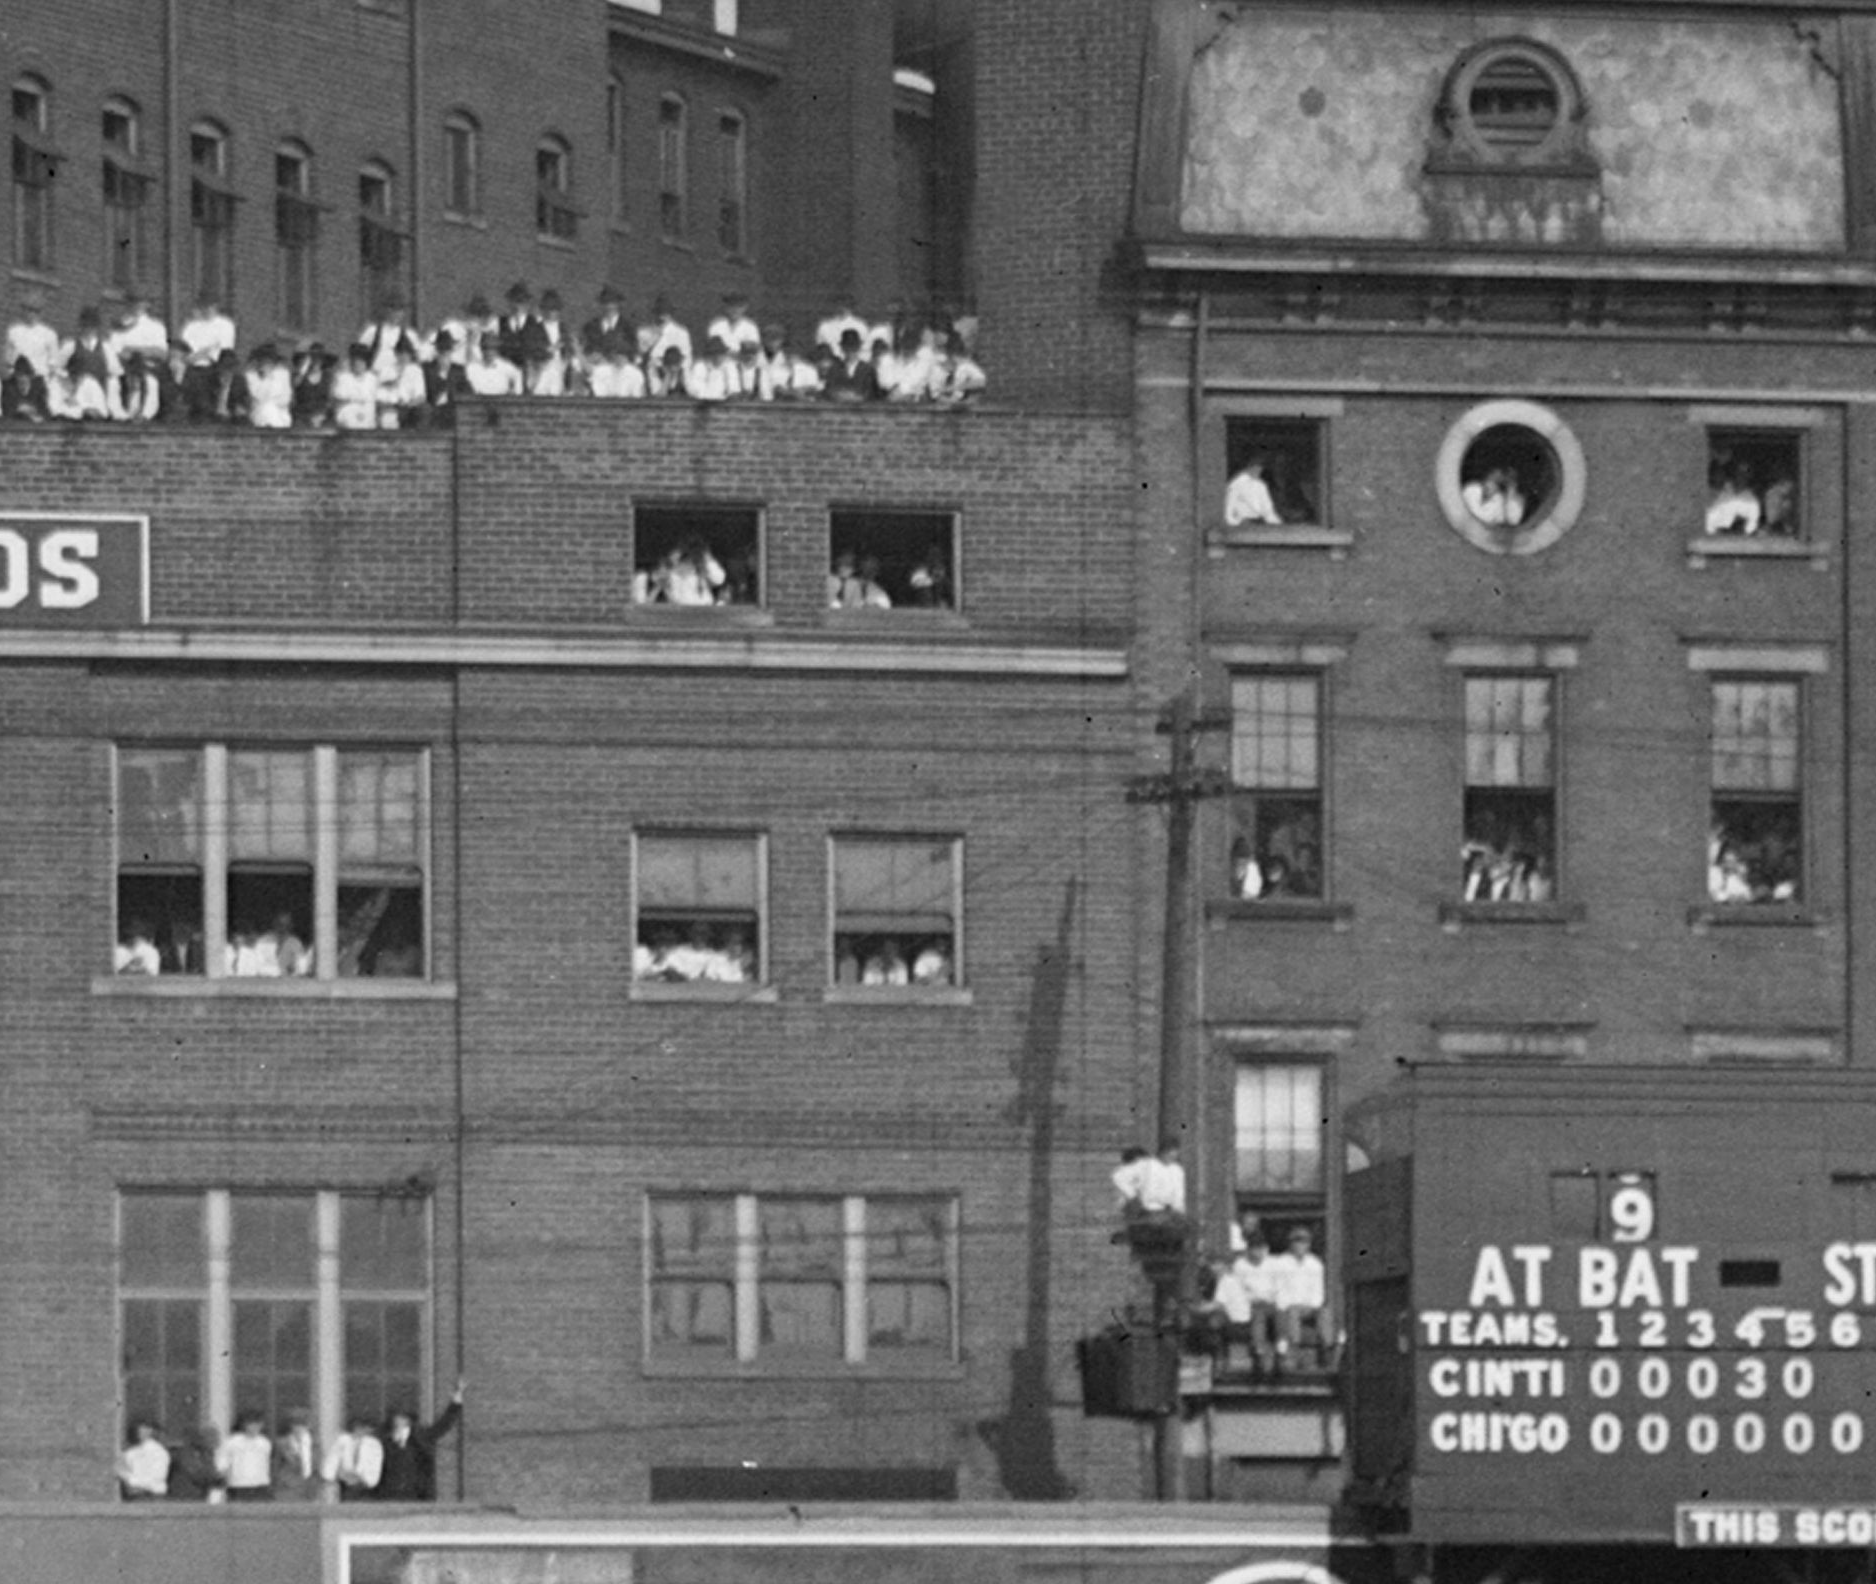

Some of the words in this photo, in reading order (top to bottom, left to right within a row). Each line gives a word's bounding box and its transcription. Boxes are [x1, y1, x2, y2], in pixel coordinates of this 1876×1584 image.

[1611, 1187, 1655, 1244] 9
[1469, 1245, 1554, 1309] AT
[1579, 1246, 1701, 1309] BAT
[1420, 1311, 1571, 1349] TEAMS.
[1596, 1310, 1621, 1349] 1
[1639, 1310, 1668, 1348] 2
[1687, 1310, 1718, 1349] 3
[1733, 1309, 1766, 1350] 4
[1784, 1312, 1817, 1349] 5
[1830, 1312, 1863, 1349] 6
[1589, 1358, 1623, 1400] 0
[1638, 1357, 1672, 1400] 0
[1687, 1357, 1721, 1401] 0
[1735, 1358, 1769, 1401] 3
[1782, 1358, 1816, 1400] 0
[1590, 1413, 1624, 1455] 0
[1637, 1414, 1672, 1456] 0
[1687, 1415, 1721, 1456] 0
[1734, 1413, 1768, 1455] 0
[1782, 1413, 1816, 1456] 0
[1831, 1412, 1865, 1455] 0
[1689, 1509, 1780, 1545] THIS
